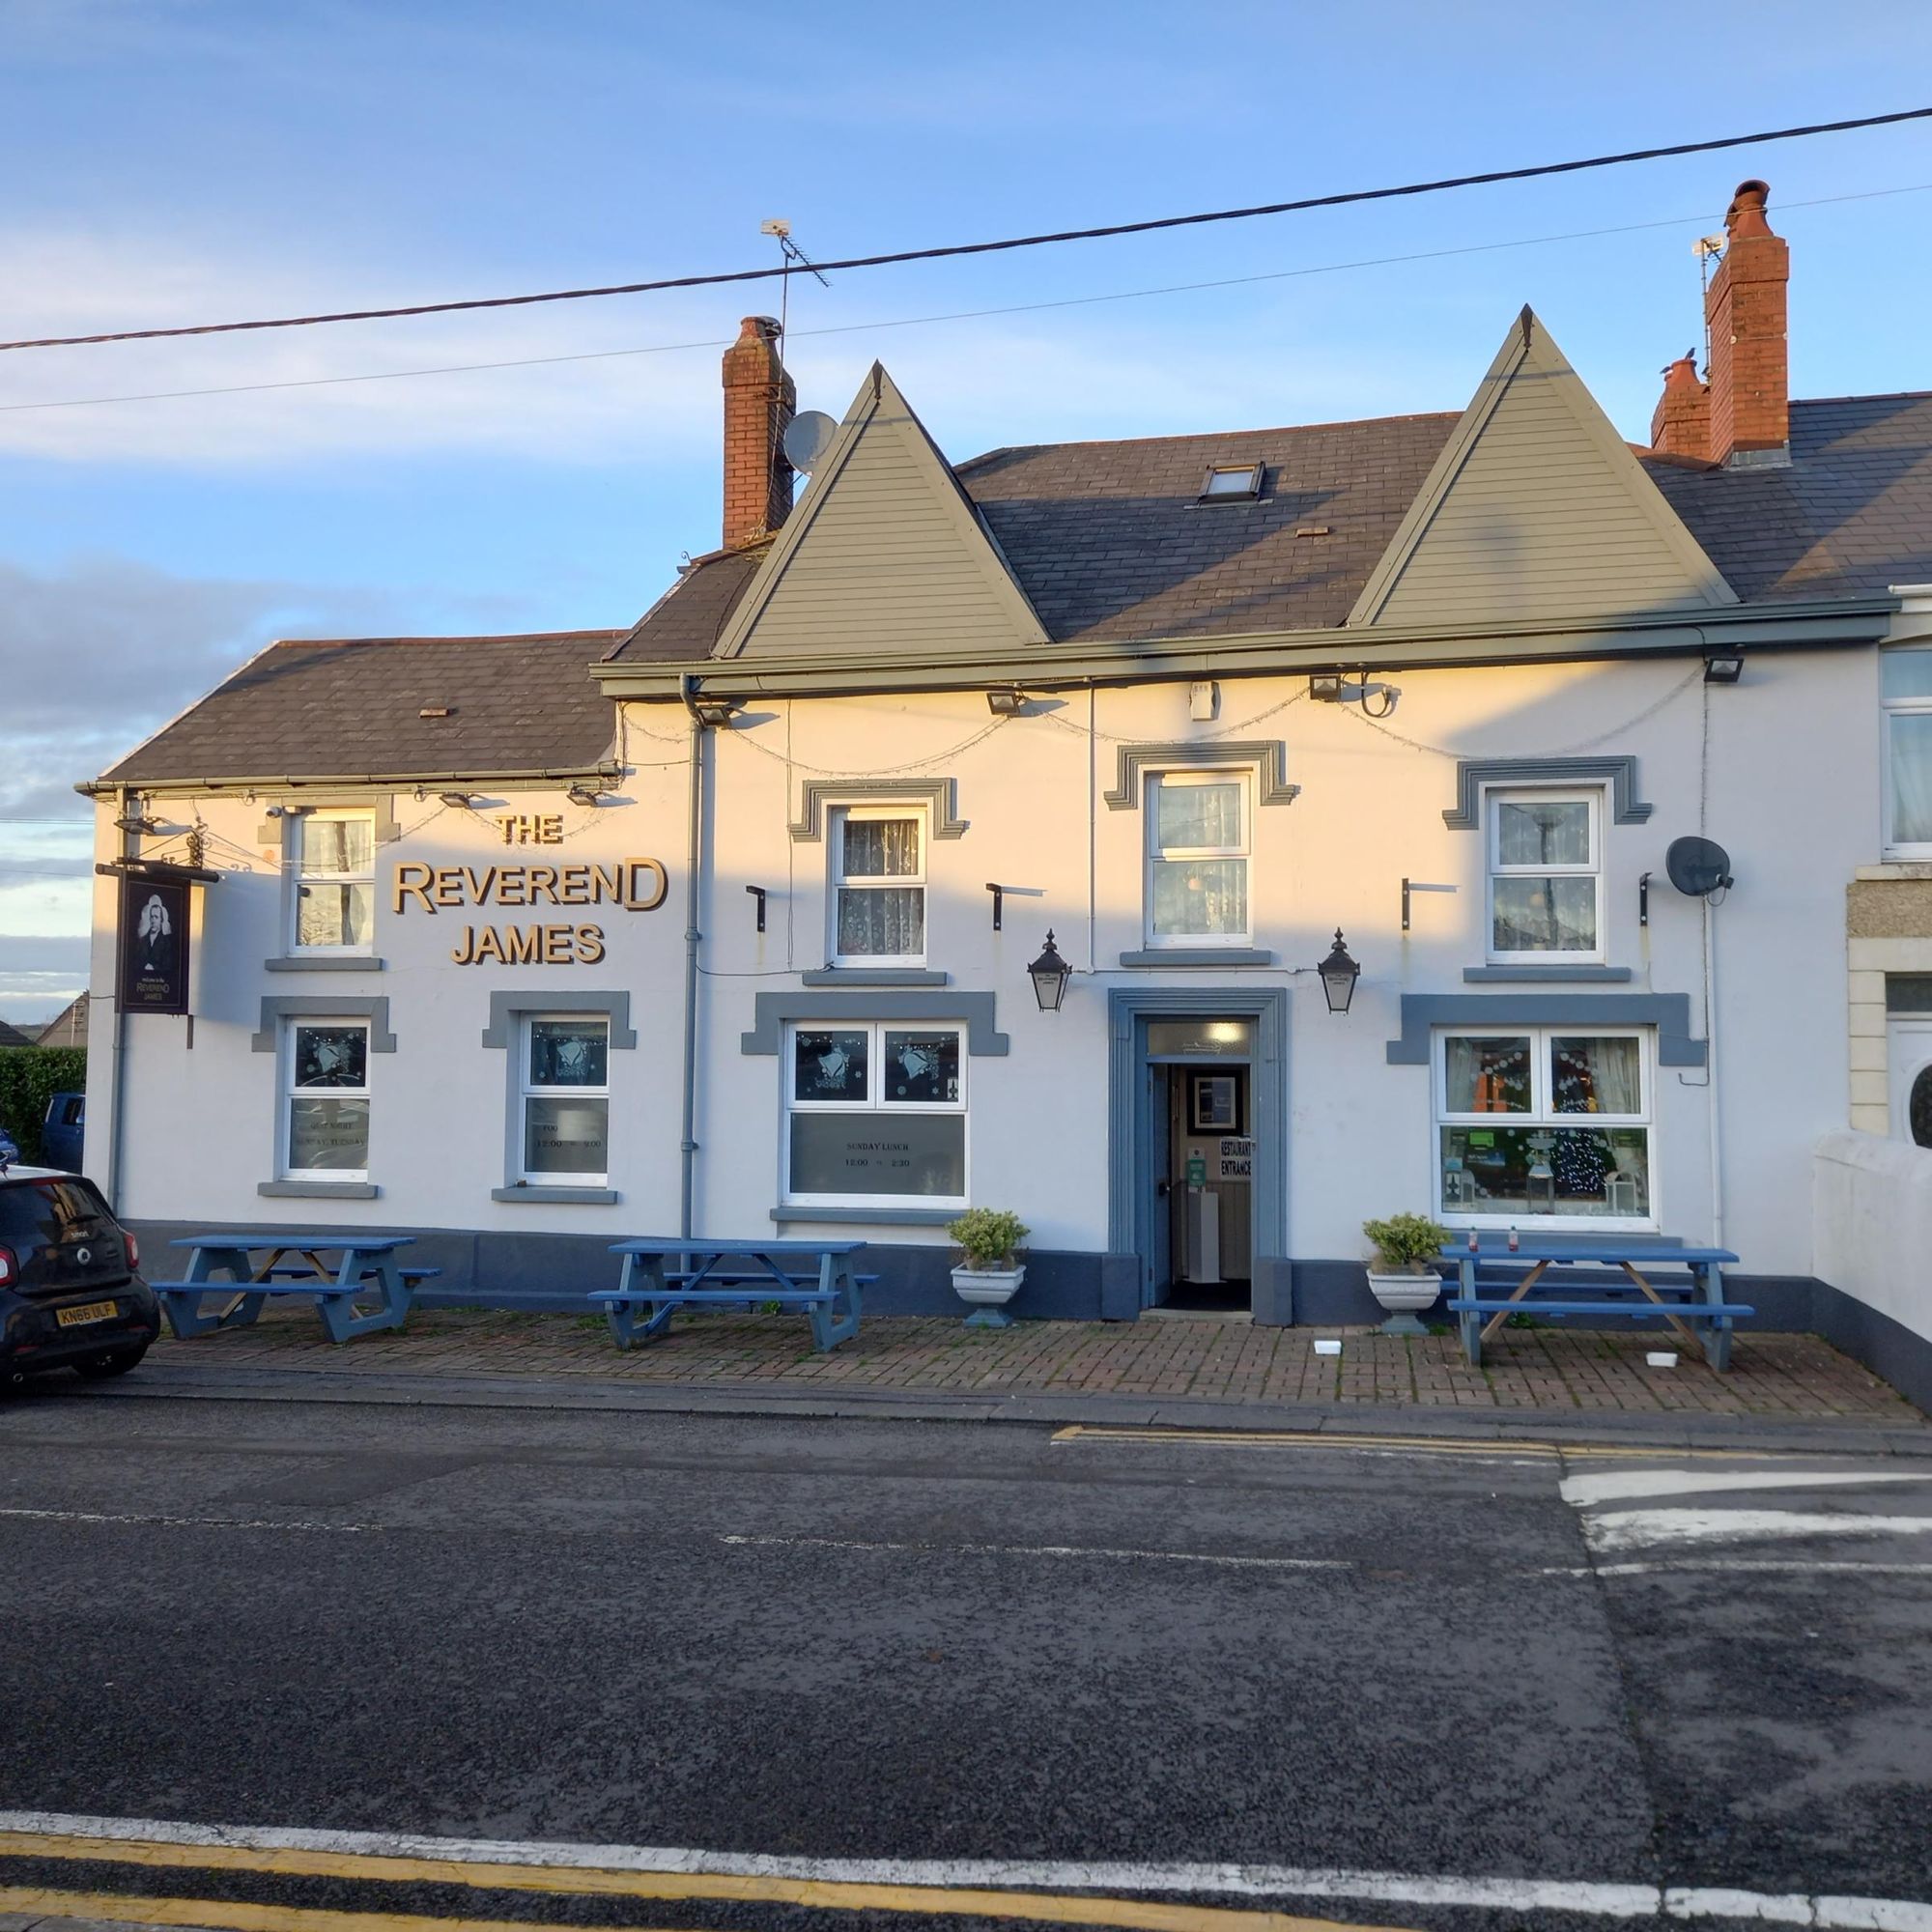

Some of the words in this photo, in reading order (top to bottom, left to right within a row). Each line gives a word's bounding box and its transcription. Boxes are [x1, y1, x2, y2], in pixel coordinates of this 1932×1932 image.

[495, 814, 564, 845] THE
[392, 857, 668, 915] REVEREND
[450, 923, 606, 965] JAMES
[846, 1143, 880, 1151] SUNDAY
[882, 1143, 909, 1151] LUNCH
[1221, 1141, 1251, 1156] RESTAURANT
[845, 1158, 868, 1167] 12:00
[1221, 1160, 1252, 1176] ENTRANCE
[61, 1307, 91, 1324] KN66
[92, 1304, 112, 1319] ULF
